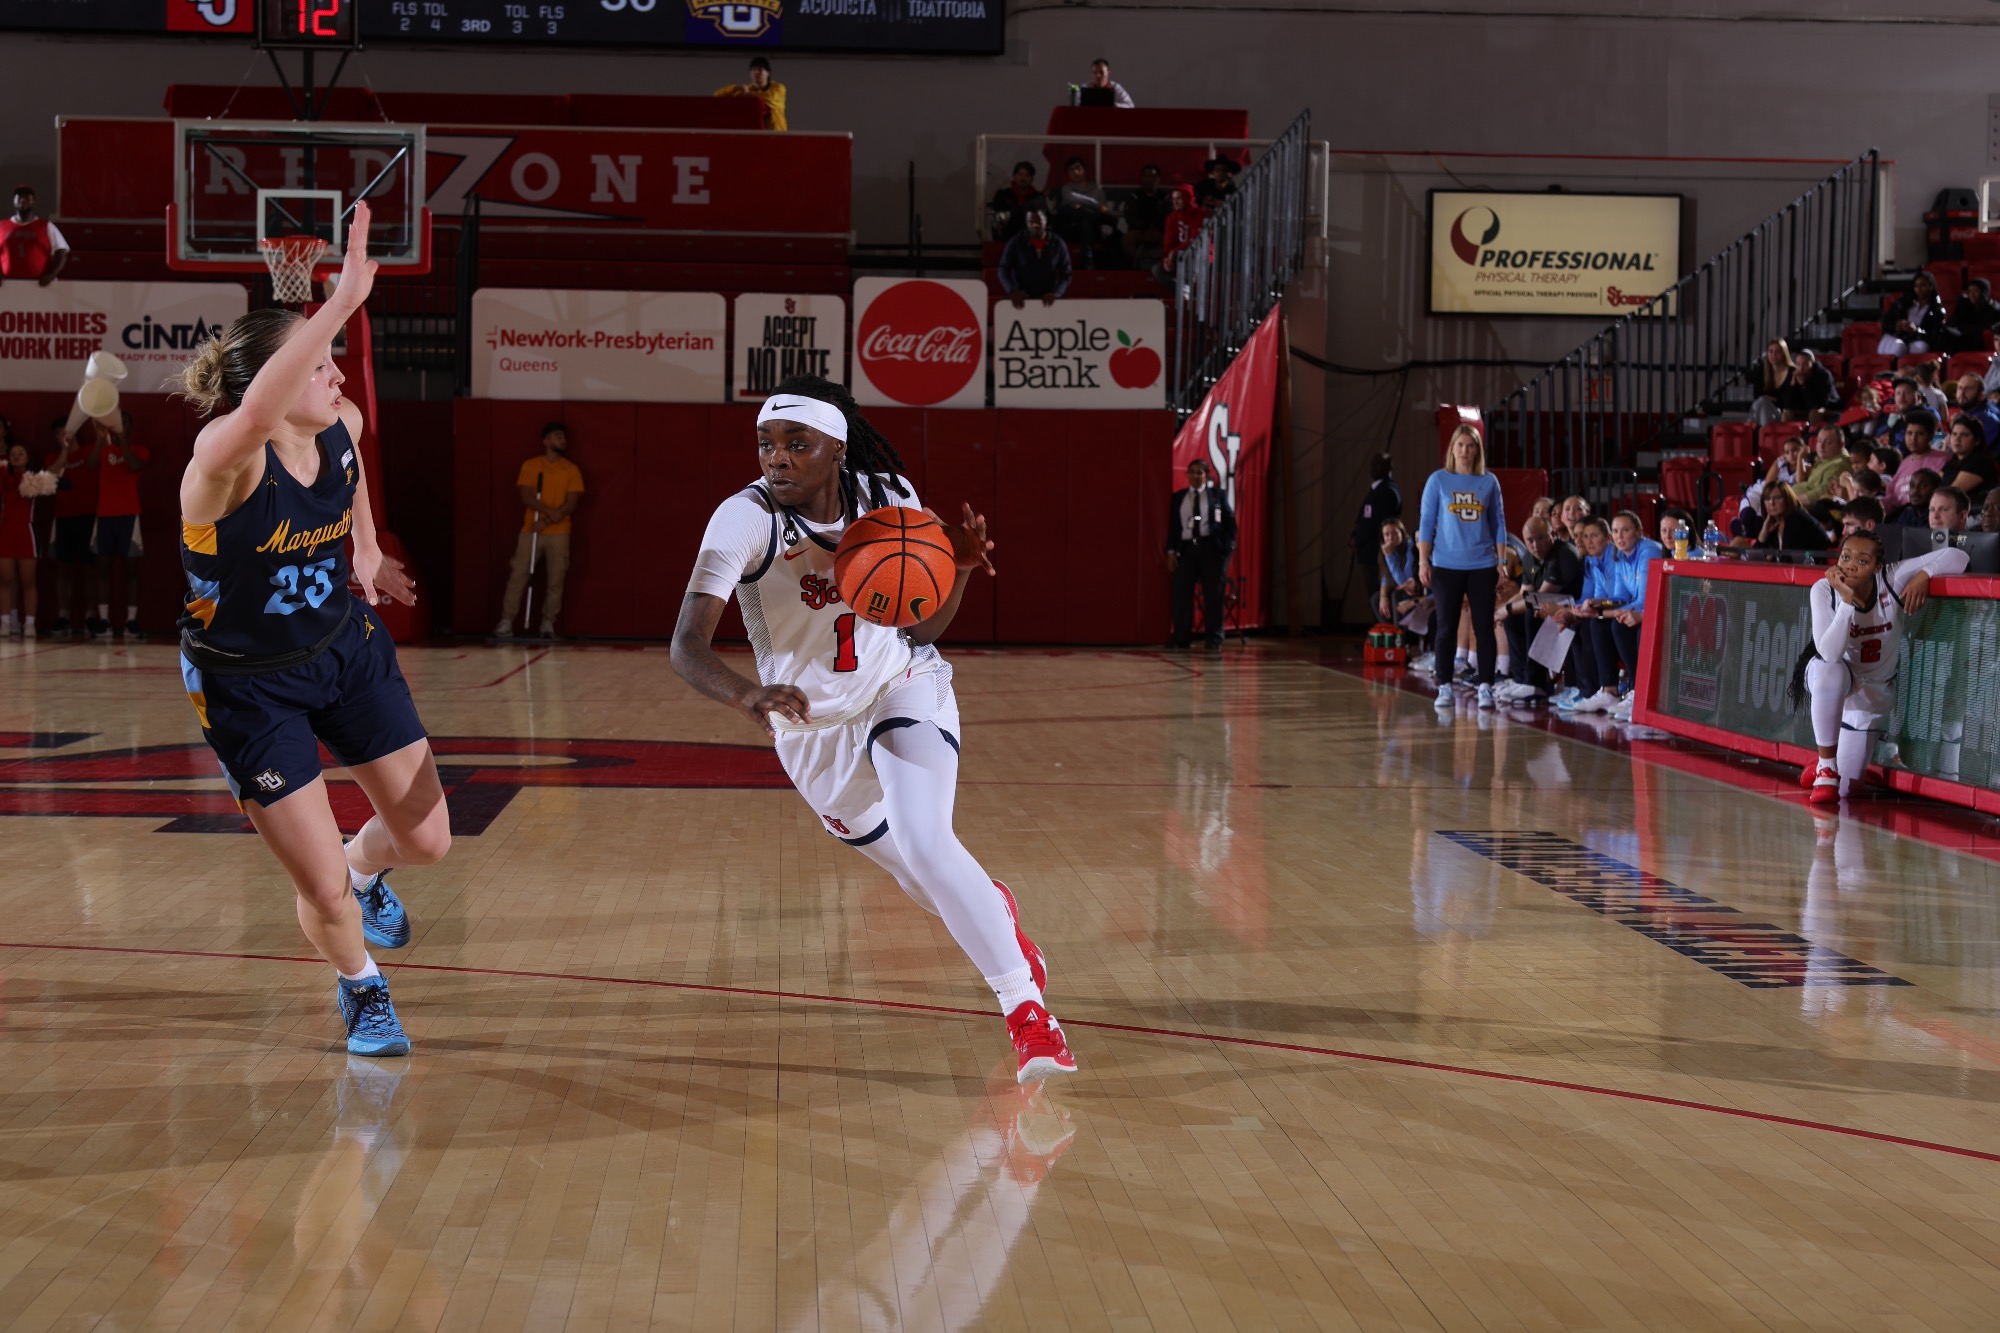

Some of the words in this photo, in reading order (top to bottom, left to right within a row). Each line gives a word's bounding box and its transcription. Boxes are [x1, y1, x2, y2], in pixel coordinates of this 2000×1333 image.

[298, 0, 339, 36] 12
[392, 2, 417, 16] FLS
[422, 3, 448, 17] TOL
[504, 4, 529, 19] TOL
[539, 5, 565, 19] FLS
[908, 0, 987, 19] TRATTORIA
[399, 18, 411, 32] 2
[430, 18, 441, 32] 4
[461, 19, 491, 33] 3RD
[512, 20, 523, 34] 3
[546, 21, 558, 35] 3
[1479, 249, 1655, 271] PROFESSIONAL
[1474, 271, 1527, 284] PHYSICAL
[1530, 272, 1581, 284] THERAPY
[0, 311, 107, 335] OHNNIES
[762, 315, 817, 348] ACCEPT
[501, 329, 714, 355] NewYork-Presbyterian
[862, 324, 977, 363] Coca-Cola
[999, 319, 1110, 359] Apple
[148, 353, 167, 362] FOR
[499, 358, 559, 373] Queens
[747, 347, 779, 395] NO
[781, 348, 831, 384] HATE
[999, 357, 1101, 389] Bank
[255, 508, 353, 557] Marquett
[784, 530, 797, 541] JK
[263, 557, 336, 616] 23
[833, 612, 859, 673] 1
[1860, 638, 1882, 663] 2
[252, 769, 286, 791] MU
